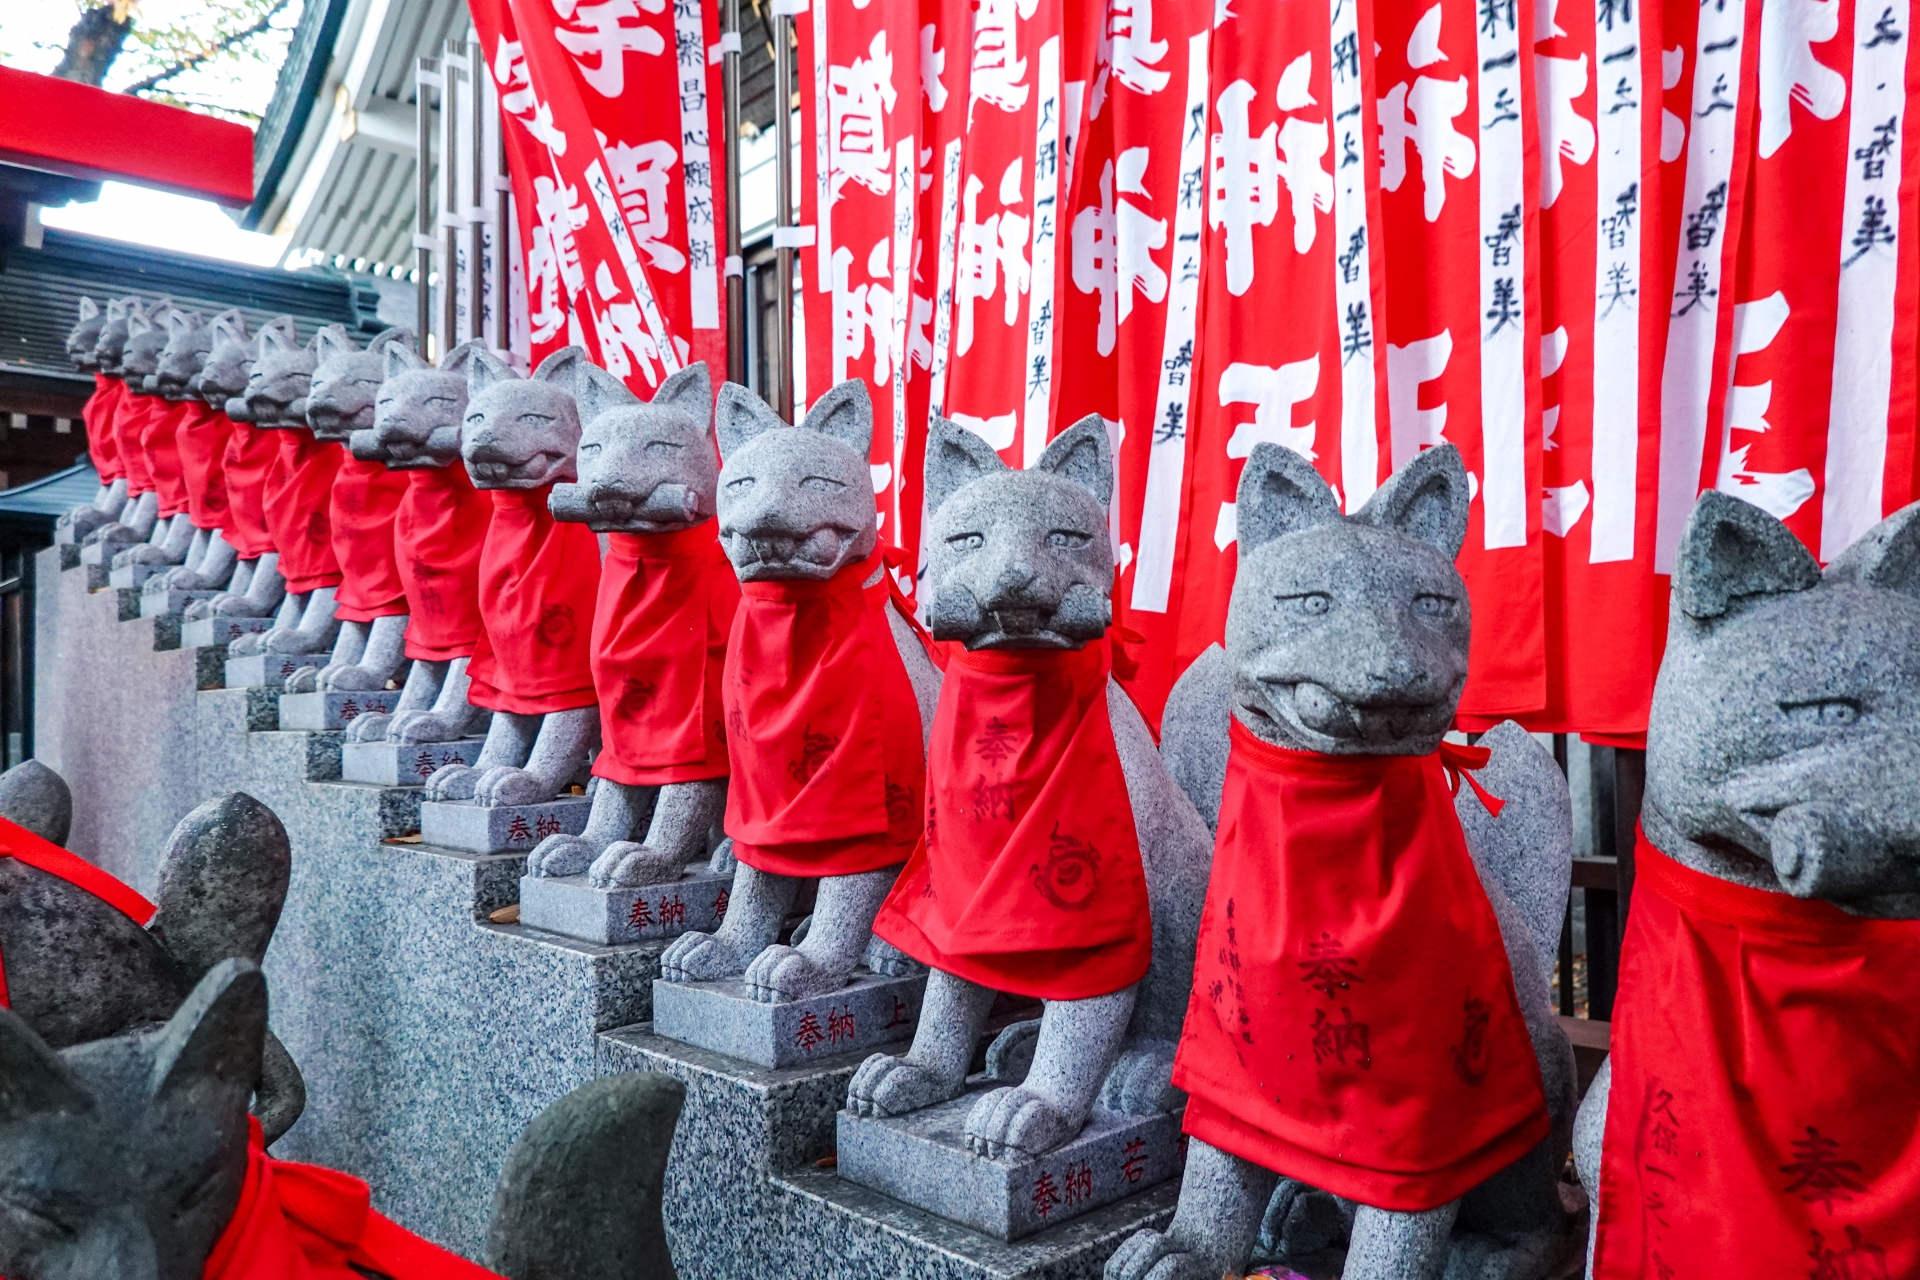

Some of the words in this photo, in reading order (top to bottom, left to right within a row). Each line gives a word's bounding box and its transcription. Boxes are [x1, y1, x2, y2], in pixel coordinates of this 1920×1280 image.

[974, 716, 1019, 823] 奉納
[507, 813, 561, 845] 奉納
[626, 895, 685, 933] 奉納
[795, 1004, 855, 1052] 奉納
[1297, 932, 1373, 1071] 奉納
[1031, 1159, 1093, 1218] 奉納
